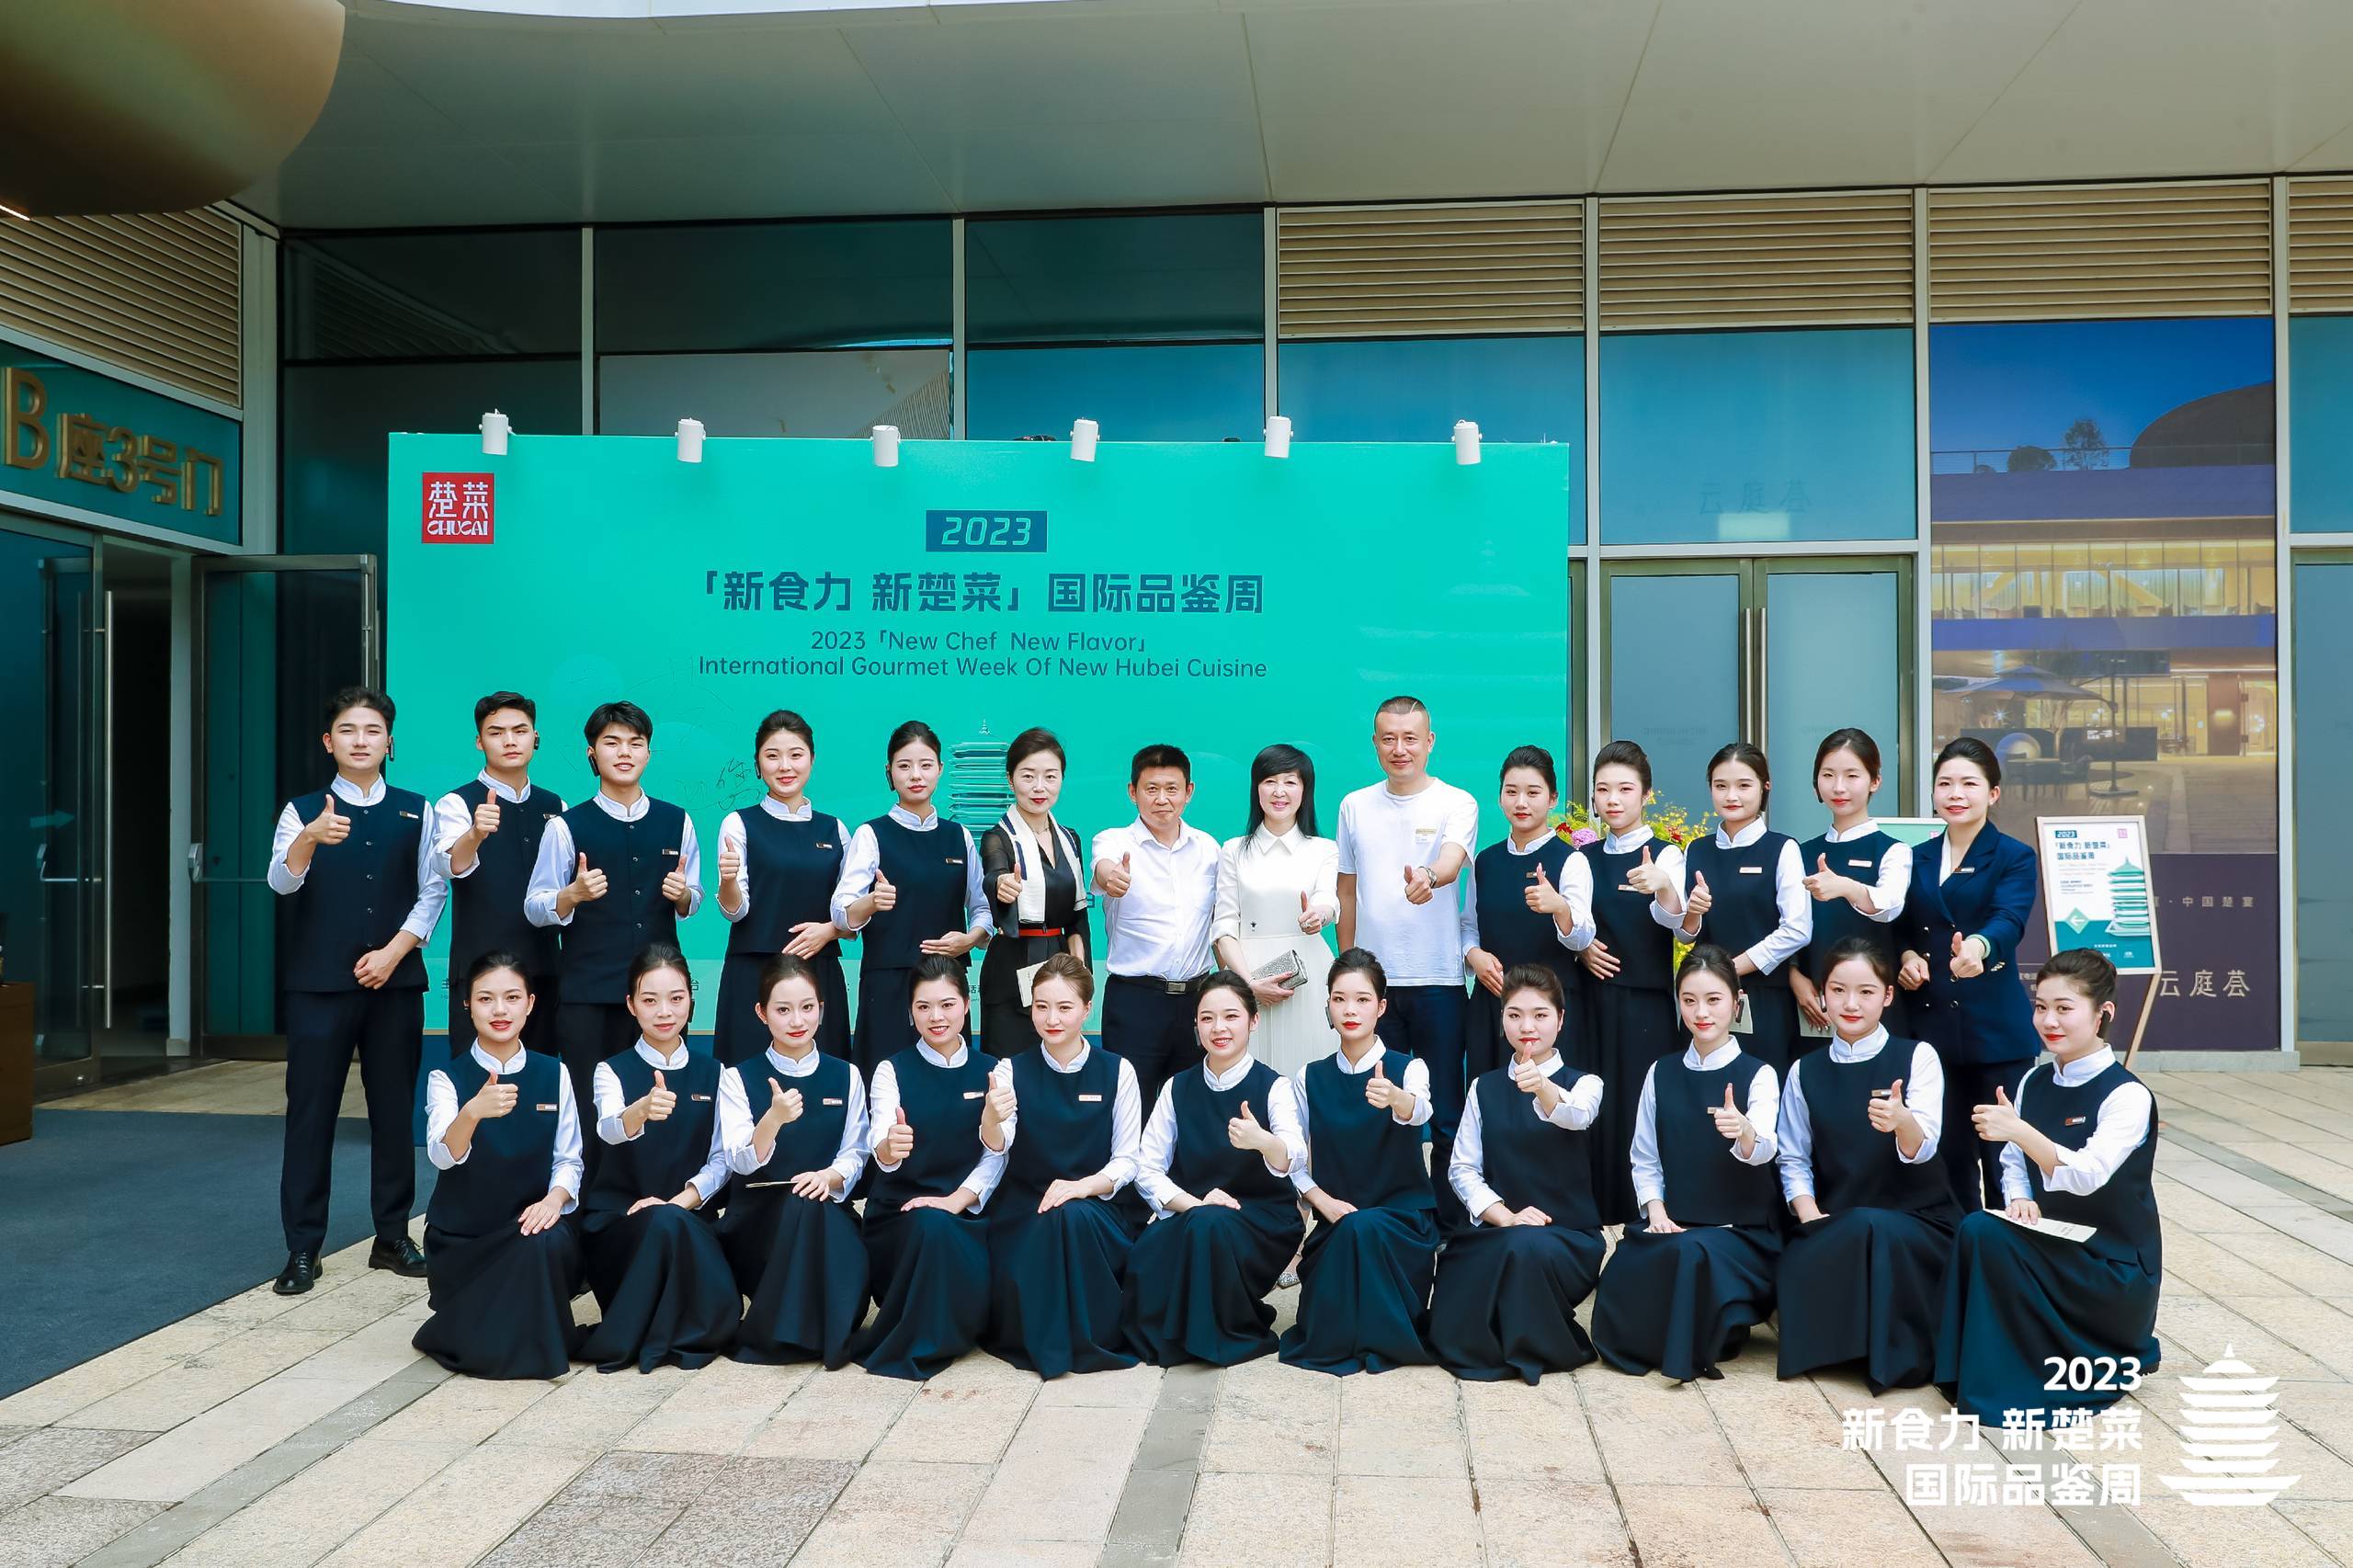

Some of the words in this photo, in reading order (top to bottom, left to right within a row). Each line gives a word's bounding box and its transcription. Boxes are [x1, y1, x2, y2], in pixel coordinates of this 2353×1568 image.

[6, 368, 224, 517] B座3号门
[428, 481, 489, 518] 楚菜
[426, 519, 489, 536] CHUCAI
[940, 516, 1032, 546] 2023
[706, 570, 851, 611] 「新食力
[871, 572, 1019, 612] 新楚菜」
[1048, 573, 1263, 613] 国际品鉴周
[811, 631, 866, 650] 2023
[946, 631, 997, 651] Chef
[1011, 631, 1060, 651] New
[699, 655, 844, 676] International
[851, 656, 949, 676] Gourmet
[956, 657, 1017, 676] Week
[1026, 656, 1052, 676] Of
[1059, 657, 1108, 676] New
[1116, 657, 1179, 677] Hubei
[1187, 658, 1267, 677] Cuisine
[2160, 969, 2250, 997] 云庭荟
